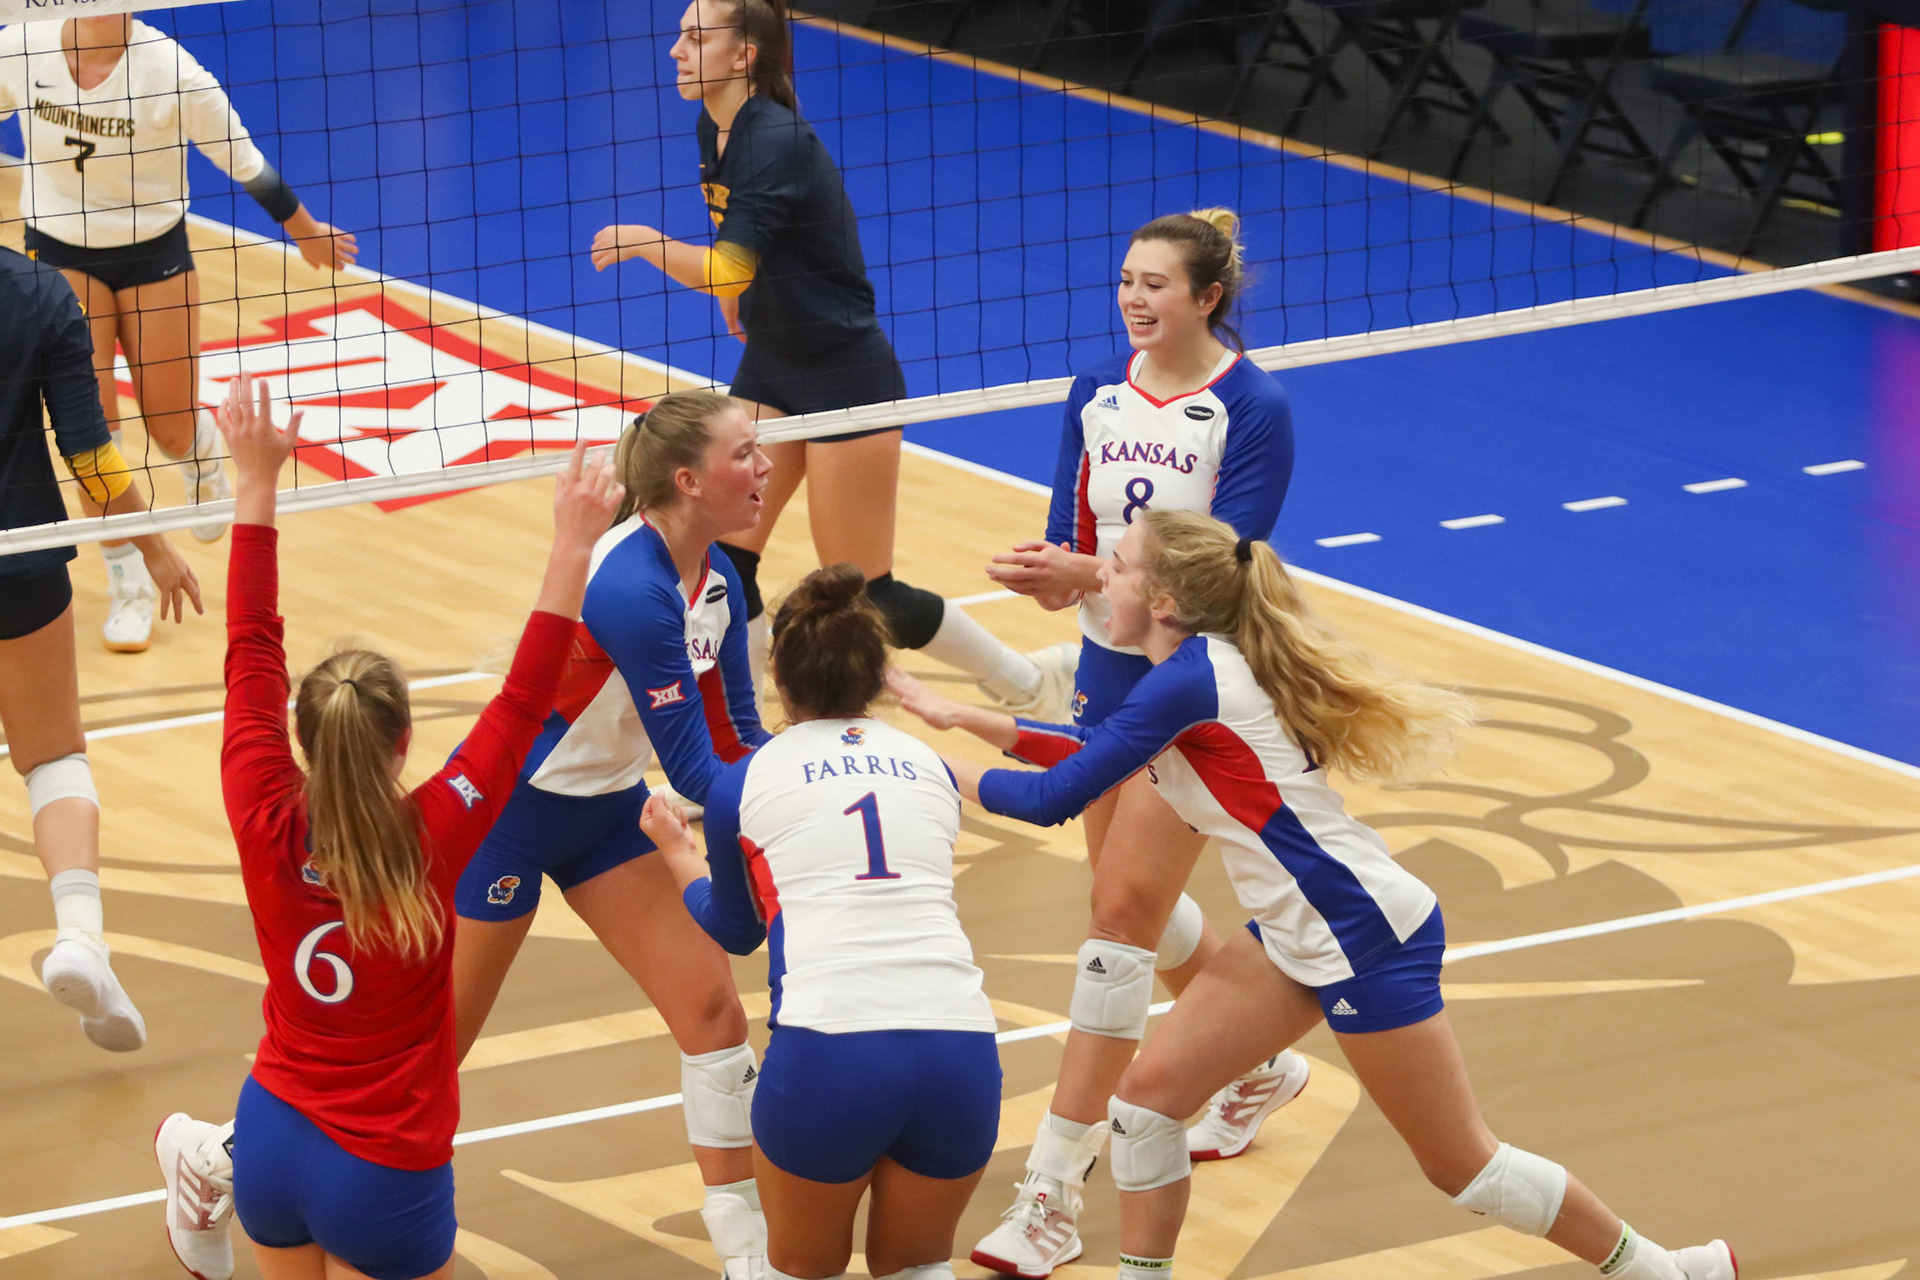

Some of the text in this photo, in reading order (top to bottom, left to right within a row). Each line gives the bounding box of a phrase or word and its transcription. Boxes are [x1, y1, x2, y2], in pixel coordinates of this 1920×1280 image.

[34, 97, 136, 138] MOUNTAINEERS
[64, 136, 96, 172] 7
[1101, 441, 1198, 474] KANSAS
[1123, 477, 1154, 525] 8
[801, 755, 917, 784] FARRIS
[843, 791, 901, 880] 1
[293, 920, 354, 1005] 6
[1086, 965, 1107, 975] adidas
